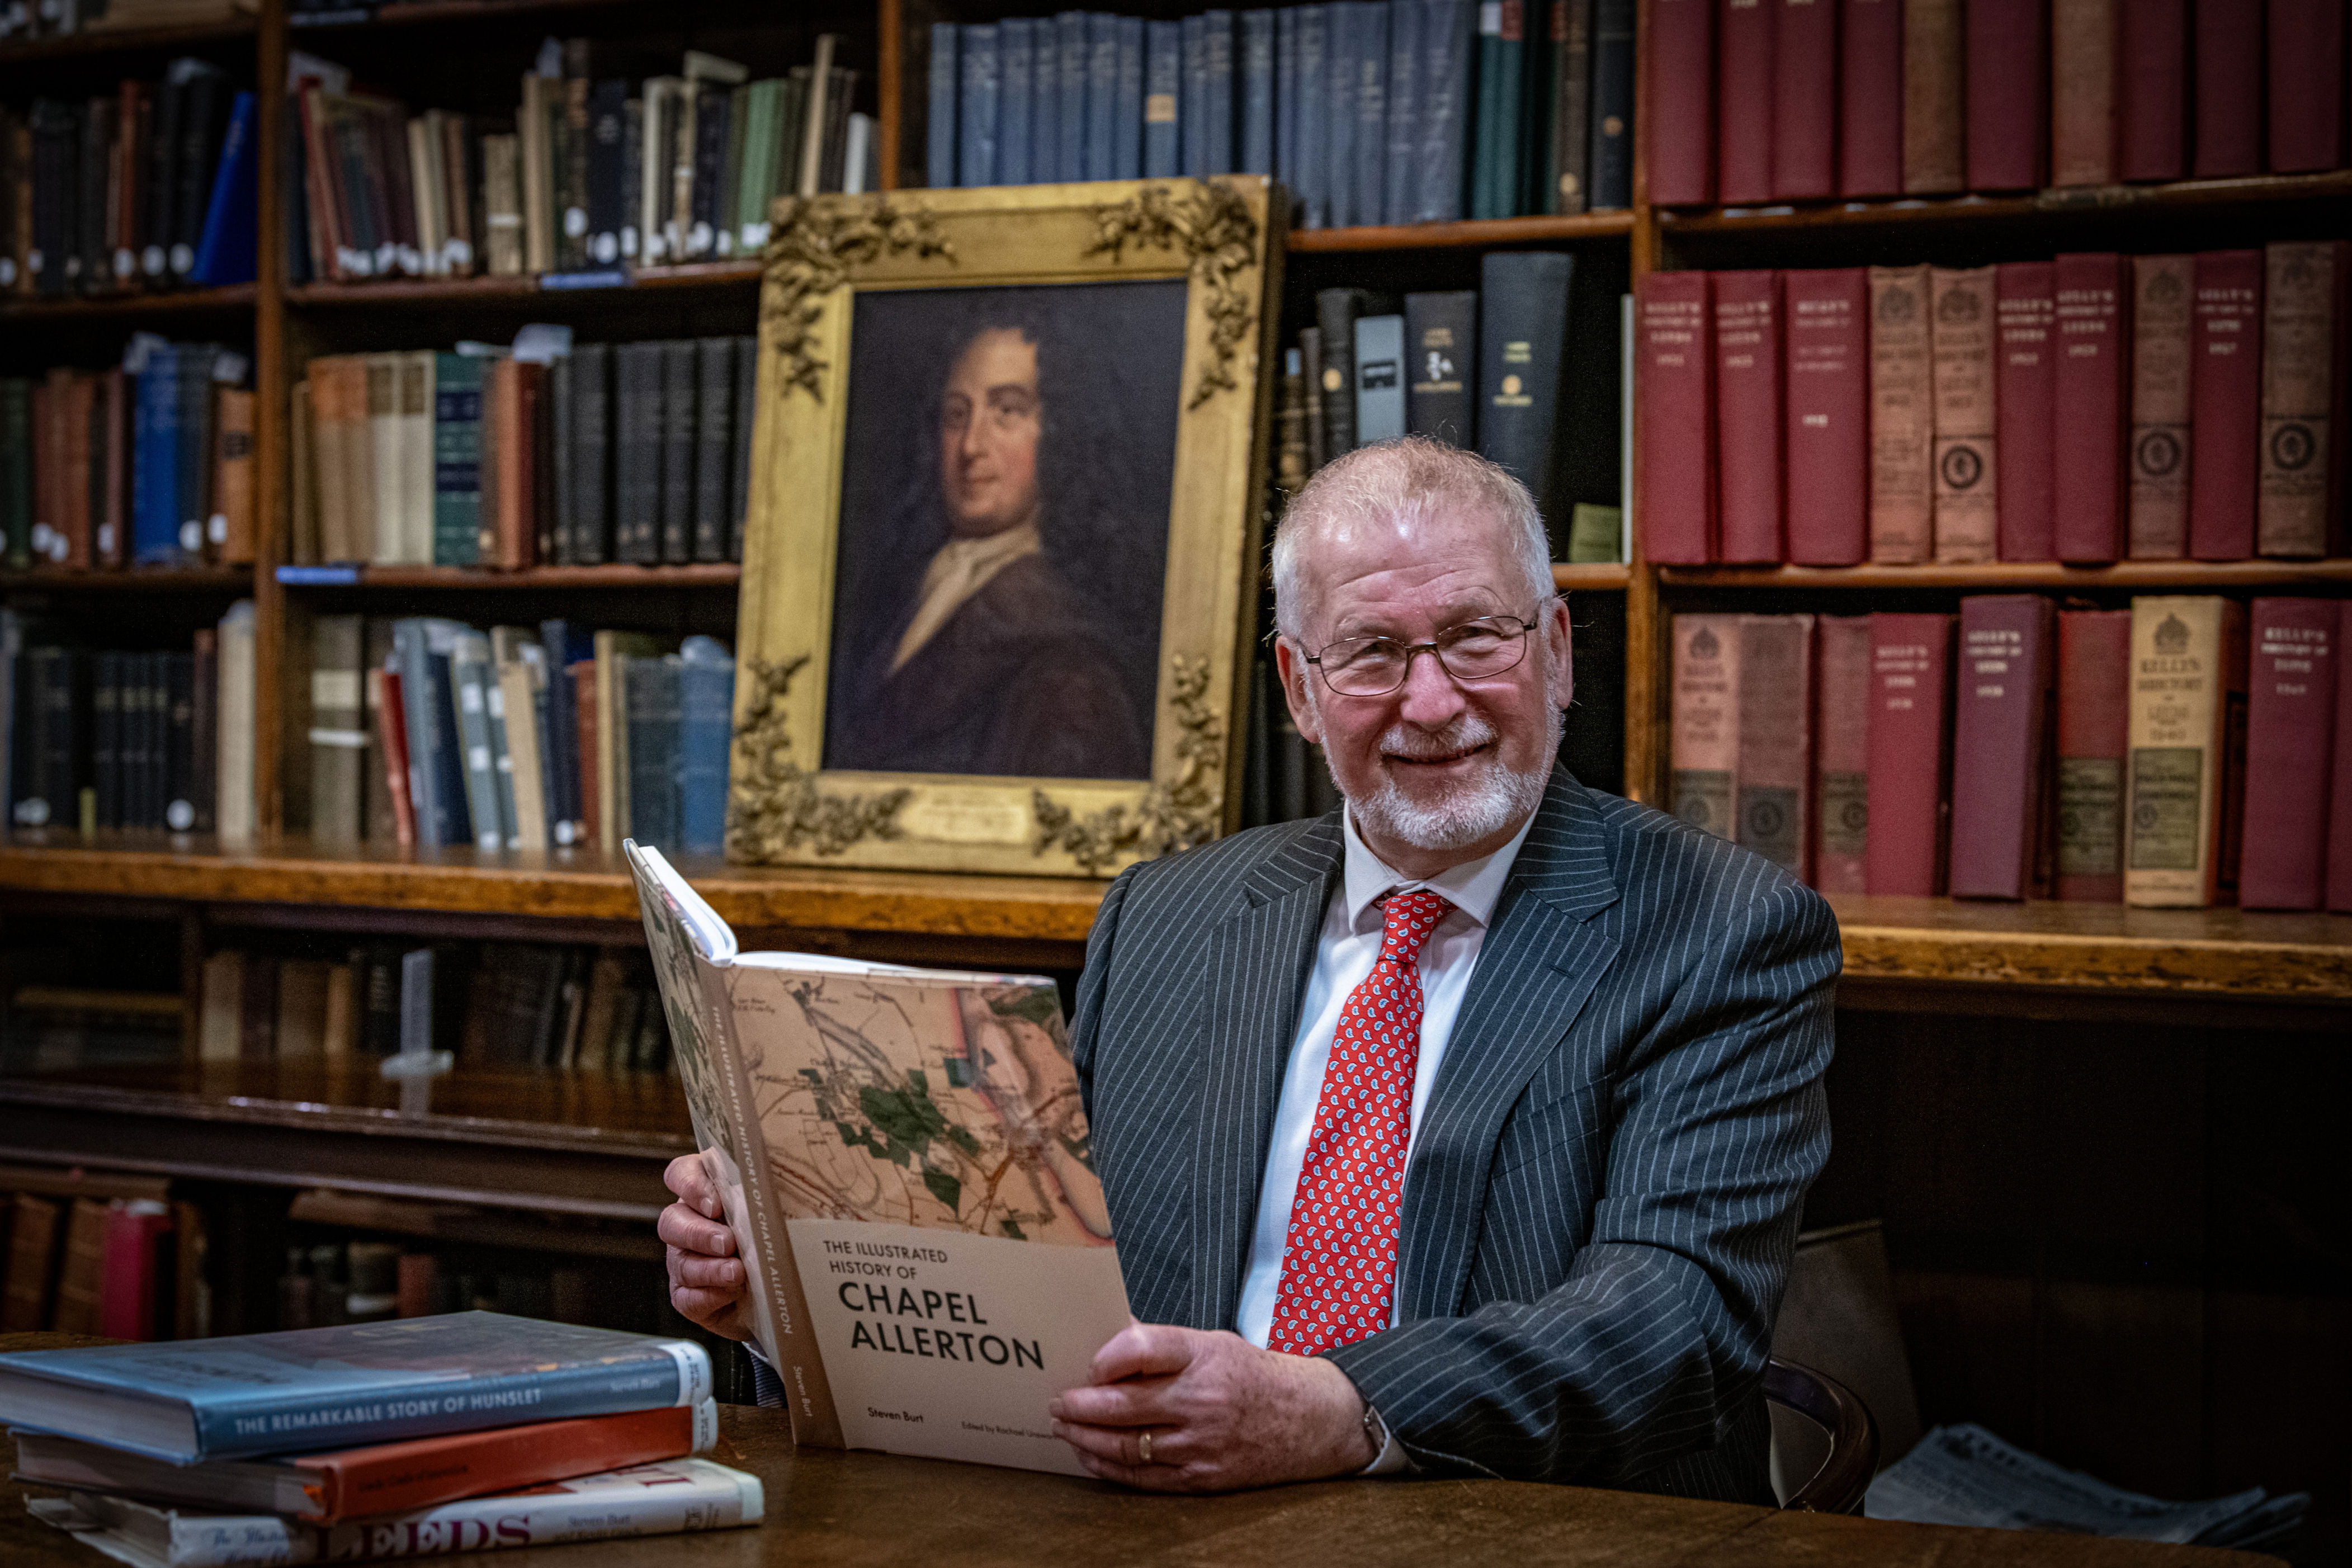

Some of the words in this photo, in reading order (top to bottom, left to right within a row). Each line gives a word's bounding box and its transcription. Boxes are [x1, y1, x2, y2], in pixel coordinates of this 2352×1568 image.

[738, 1126, 759, 1184] HISTORY
[753, 1189, 764, 1208] OF
[758, 1212, 776, 1263] CHAPEL
[823, 1240, 852, 1254] THE
[856, 1242, 948, 1263] ILLUSTRATED
[829, 1260, 891, 1277] HISTORY
[897, 1266, 918, 1280] OF
[770, 1267, 794, 1335] ALLERTON
[839, 1281, 988, 1325] CHAPEL
[851, 1320, 1045, 1371] ALLERTON
[234, 1414, 267, 1435] THE
[271, 1404, 384, 1432] REMARKABLE
[386, 1397, 439, 1420] STORY
[443, 1396, 465, 1413] OF
[470, 1387, 543, 1410] HUNSLET
[793, 1366, 806, 1396] Steven
[801, 1398, 814, 1418] Burt
[867, 1406, 901, 1421] Steven
[903, 1411, 924, 1424] Burt
[315, 1514, 532, 1560] LEEDS
